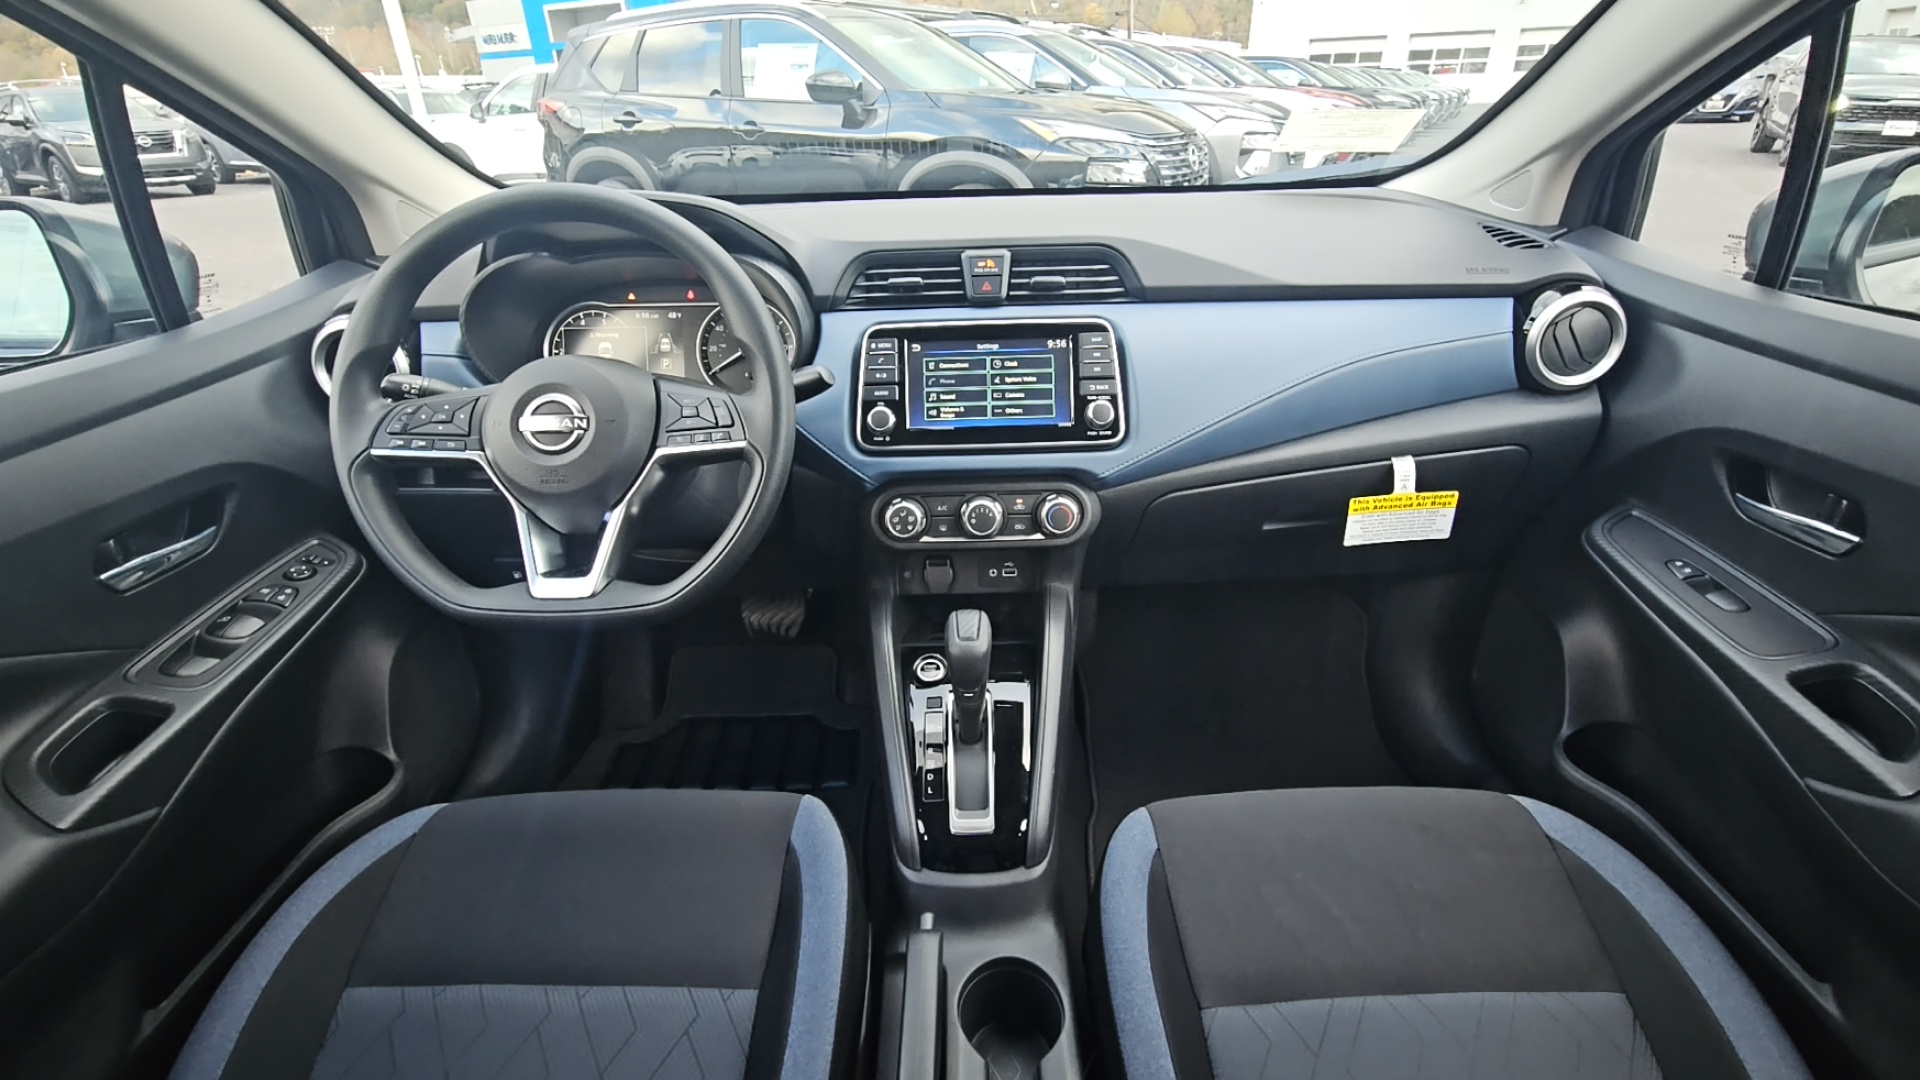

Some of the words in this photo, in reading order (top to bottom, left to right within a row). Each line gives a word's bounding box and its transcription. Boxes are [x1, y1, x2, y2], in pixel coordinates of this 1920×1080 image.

[1046, 339, 1067, 349] 9:56
[1415, 493, 1455, 502] Equipped
[1372, 503, 1413, 511] Advanced
[1430, 500, 1452, 508] Bags
[926, 772, 934, 781] D
[927, 786, 933, 794] L
